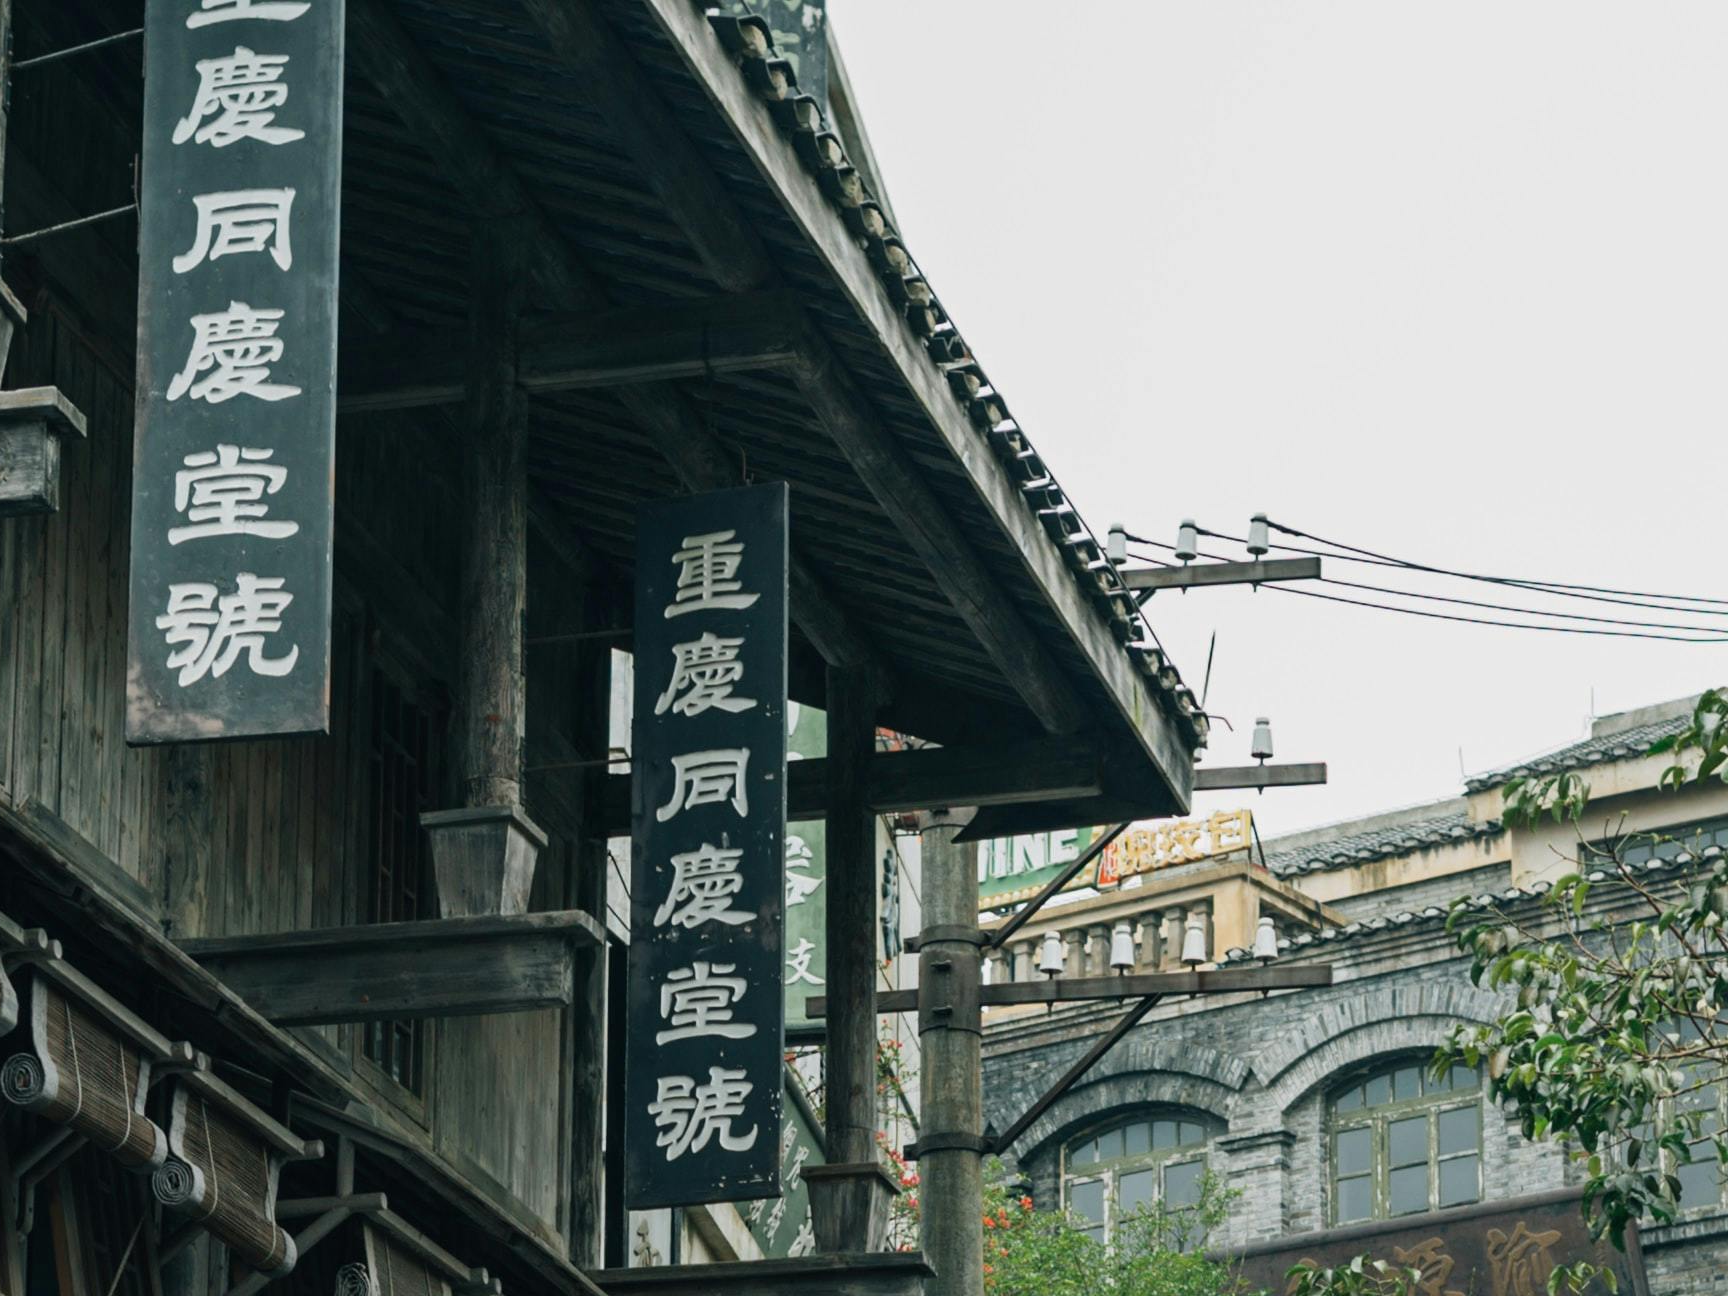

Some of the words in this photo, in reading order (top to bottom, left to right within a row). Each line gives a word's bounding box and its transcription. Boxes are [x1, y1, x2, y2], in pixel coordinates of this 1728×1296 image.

[646, 529, 761, 1162] 重慶同慶堂號
